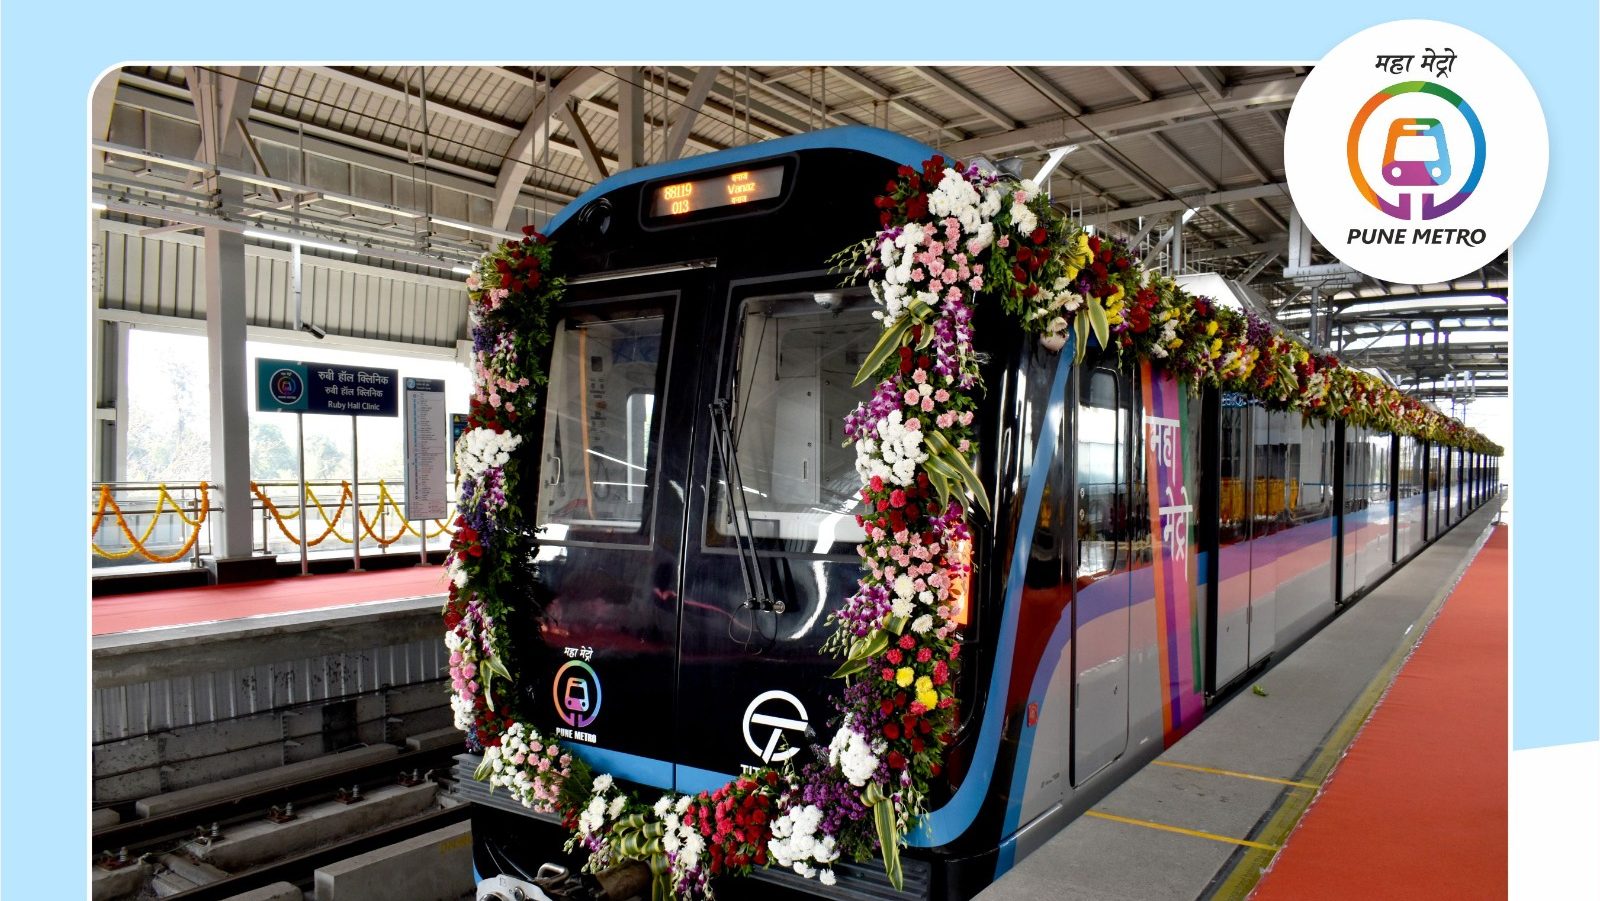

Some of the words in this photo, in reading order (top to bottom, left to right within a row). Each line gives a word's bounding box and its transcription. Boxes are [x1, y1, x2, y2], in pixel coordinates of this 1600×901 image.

[663, 182, 692, 200] 88119
[727, 182, 756, 195] Vanaz
[671, 199, 689, 215] 013
[338, 370, 354, 383] हॉल
[357, 371, 390, 385] क्लिनिक
[328, 400, 346, 411] Ruby
[347, 401, 361, 410] Hall
[361, 402, 380, 411] Clinic
[1145, 415, 1180, 487] महा
[1159, 485, 1194, 583] मेट्रो
[564, 647, 579, 658] महा
[580, 645, 594, 662] मेट्रो
[555, 727, 574, 739] PUNE
[574, 730, 597, 744] METRO
